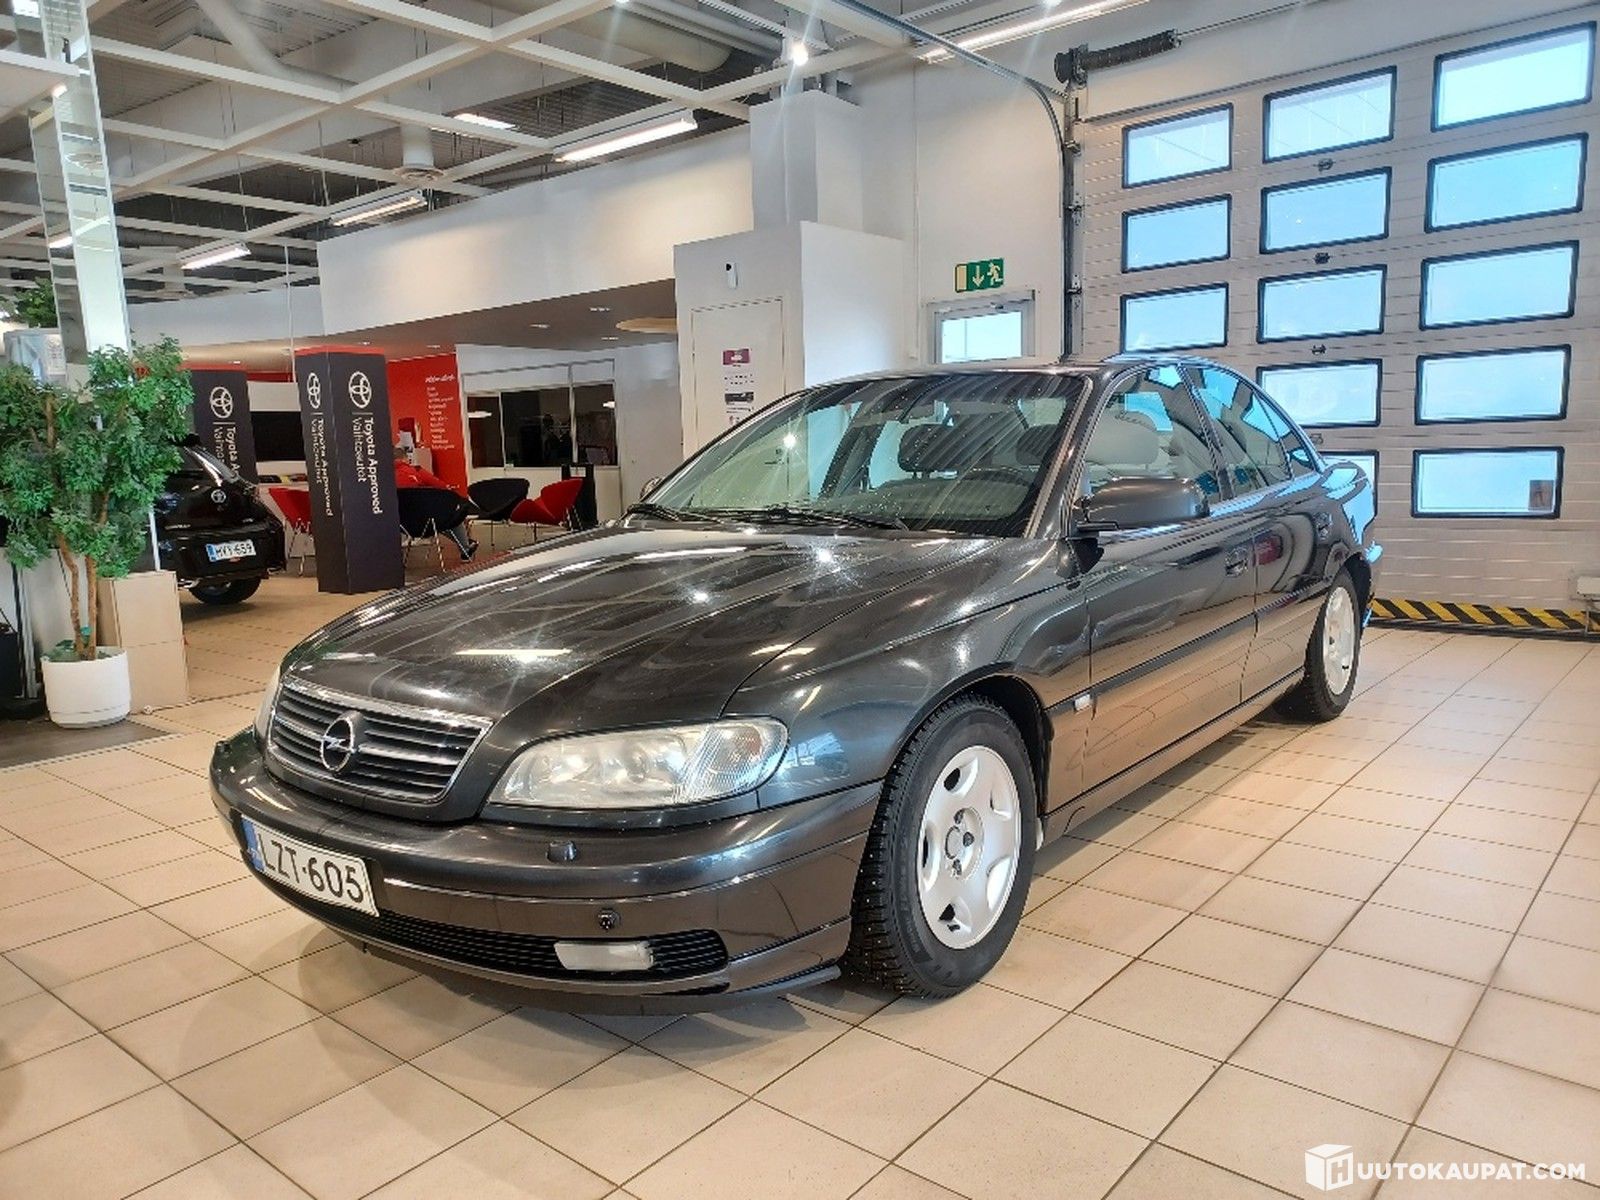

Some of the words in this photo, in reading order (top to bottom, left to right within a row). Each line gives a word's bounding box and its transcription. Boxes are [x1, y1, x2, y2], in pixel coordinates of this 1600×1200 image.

[225, 426, 238, 462] Toyota
[317, 418, 326, 457] Toyota
[364, 417, 376, 455] Toyota
[321, 459, 334, 516] Approved
[367, 458, 383, 515] Approved
[258, 833, 364, 903] LZT-605
